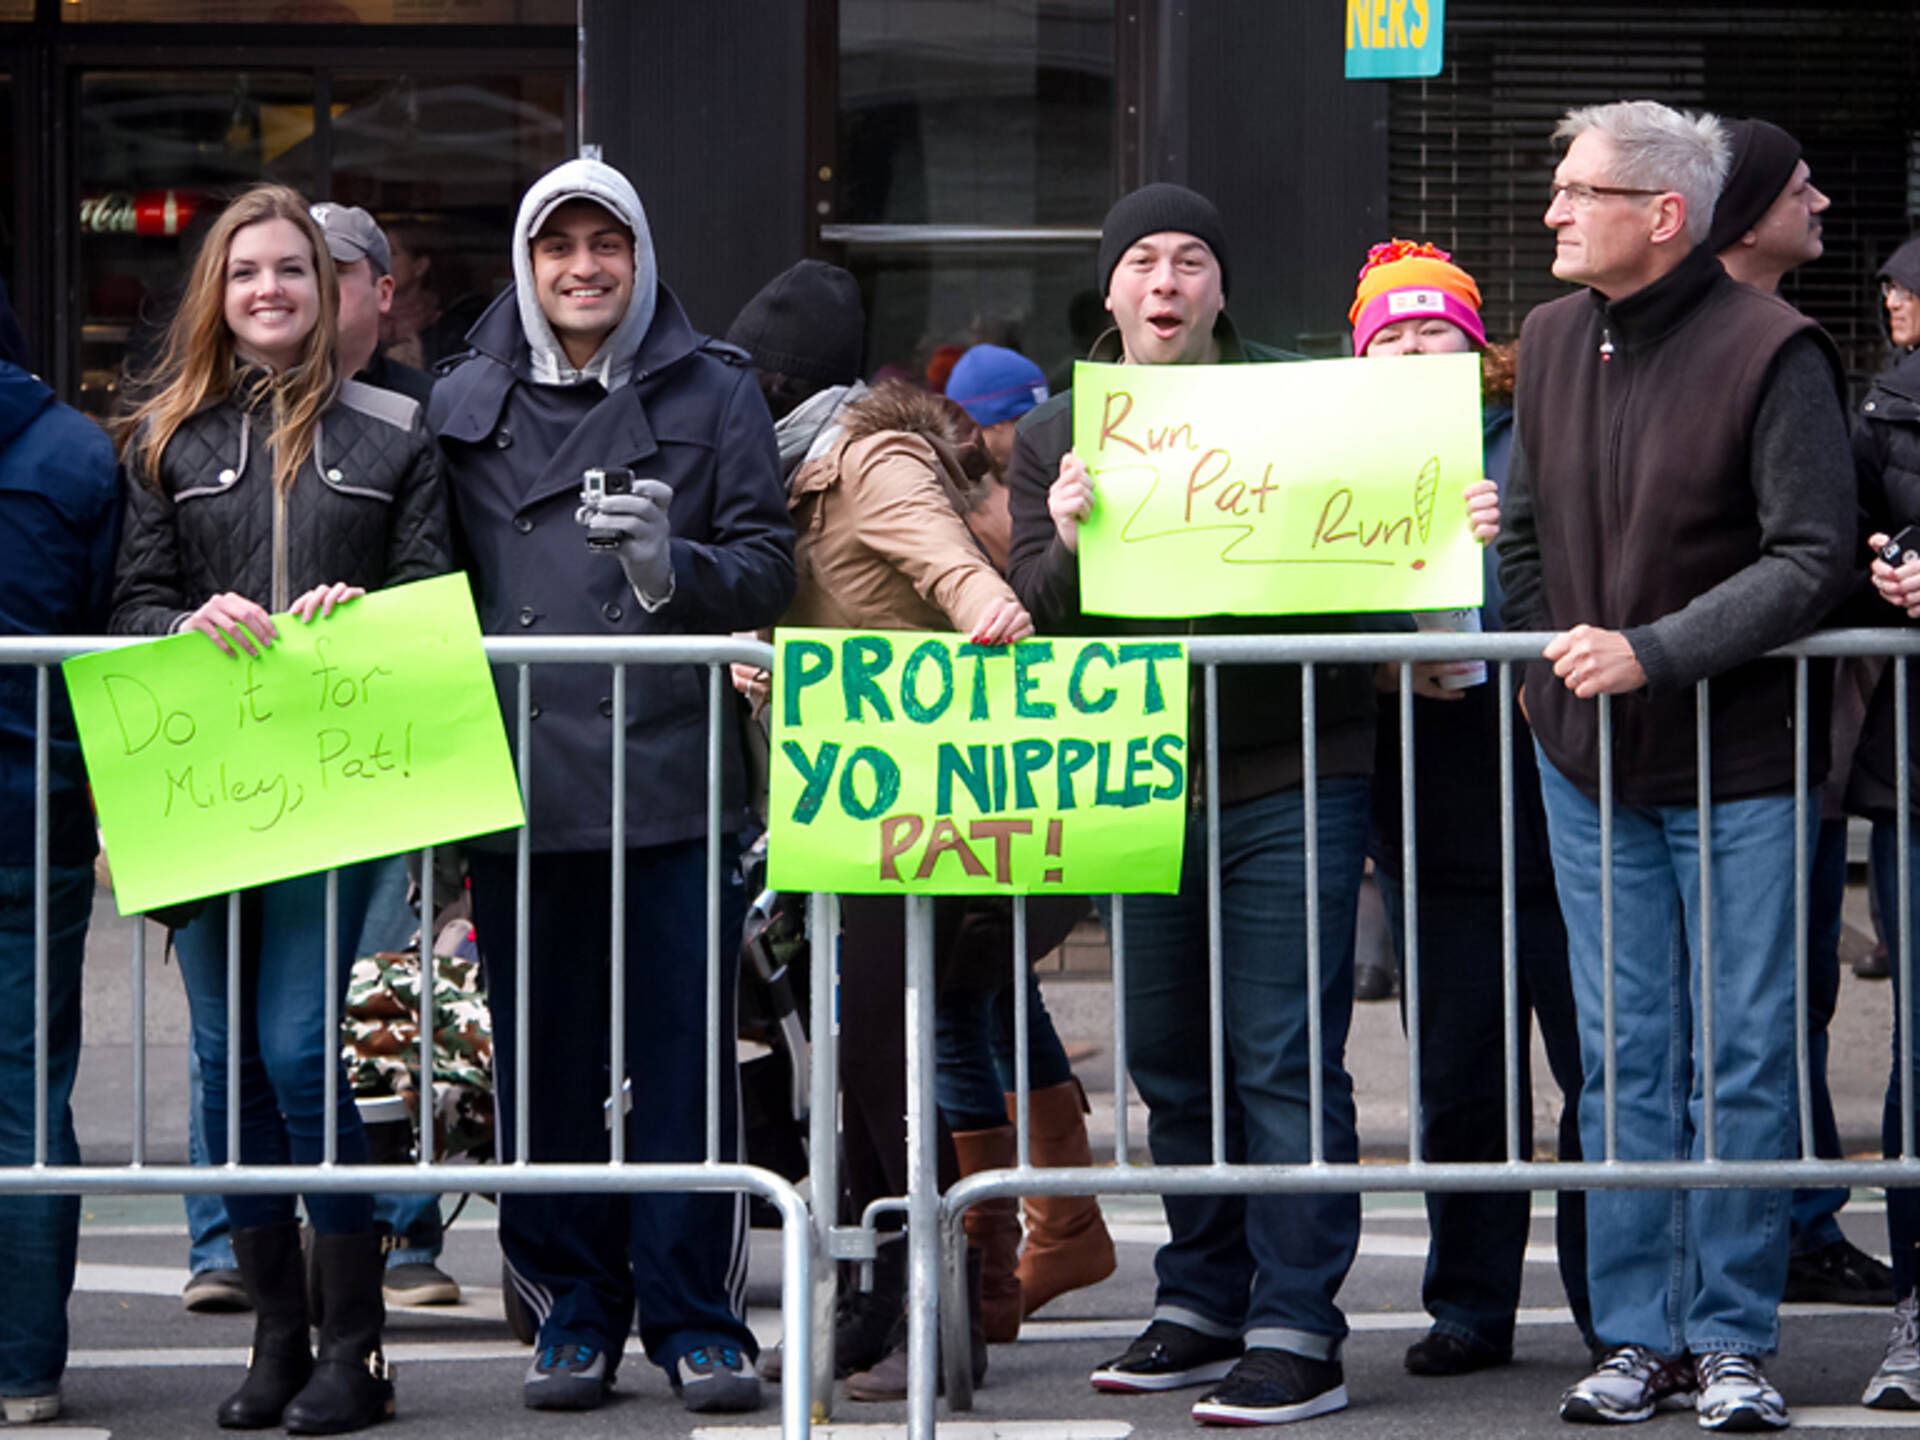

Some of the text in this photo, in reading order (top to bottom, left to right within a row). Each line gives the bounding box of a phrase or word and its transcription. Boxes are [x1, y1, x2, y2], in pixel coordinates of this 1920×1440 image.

[1346, 0, 1429, 49] NERS
[1099, 391, 1198, 456] Run
[1184, 449, 1279, 523] Pat
[1312, 456, 1441, 570] Run!
[103, 637, 393, 755] Do it for
[783, 636, 1183, 728] PROTECT
[164, 722, 413, 832] Miley, Pat!
[780, 733, 1186, 826] YO NIPPLES
[879, 814, 1064, 886] PAT!
